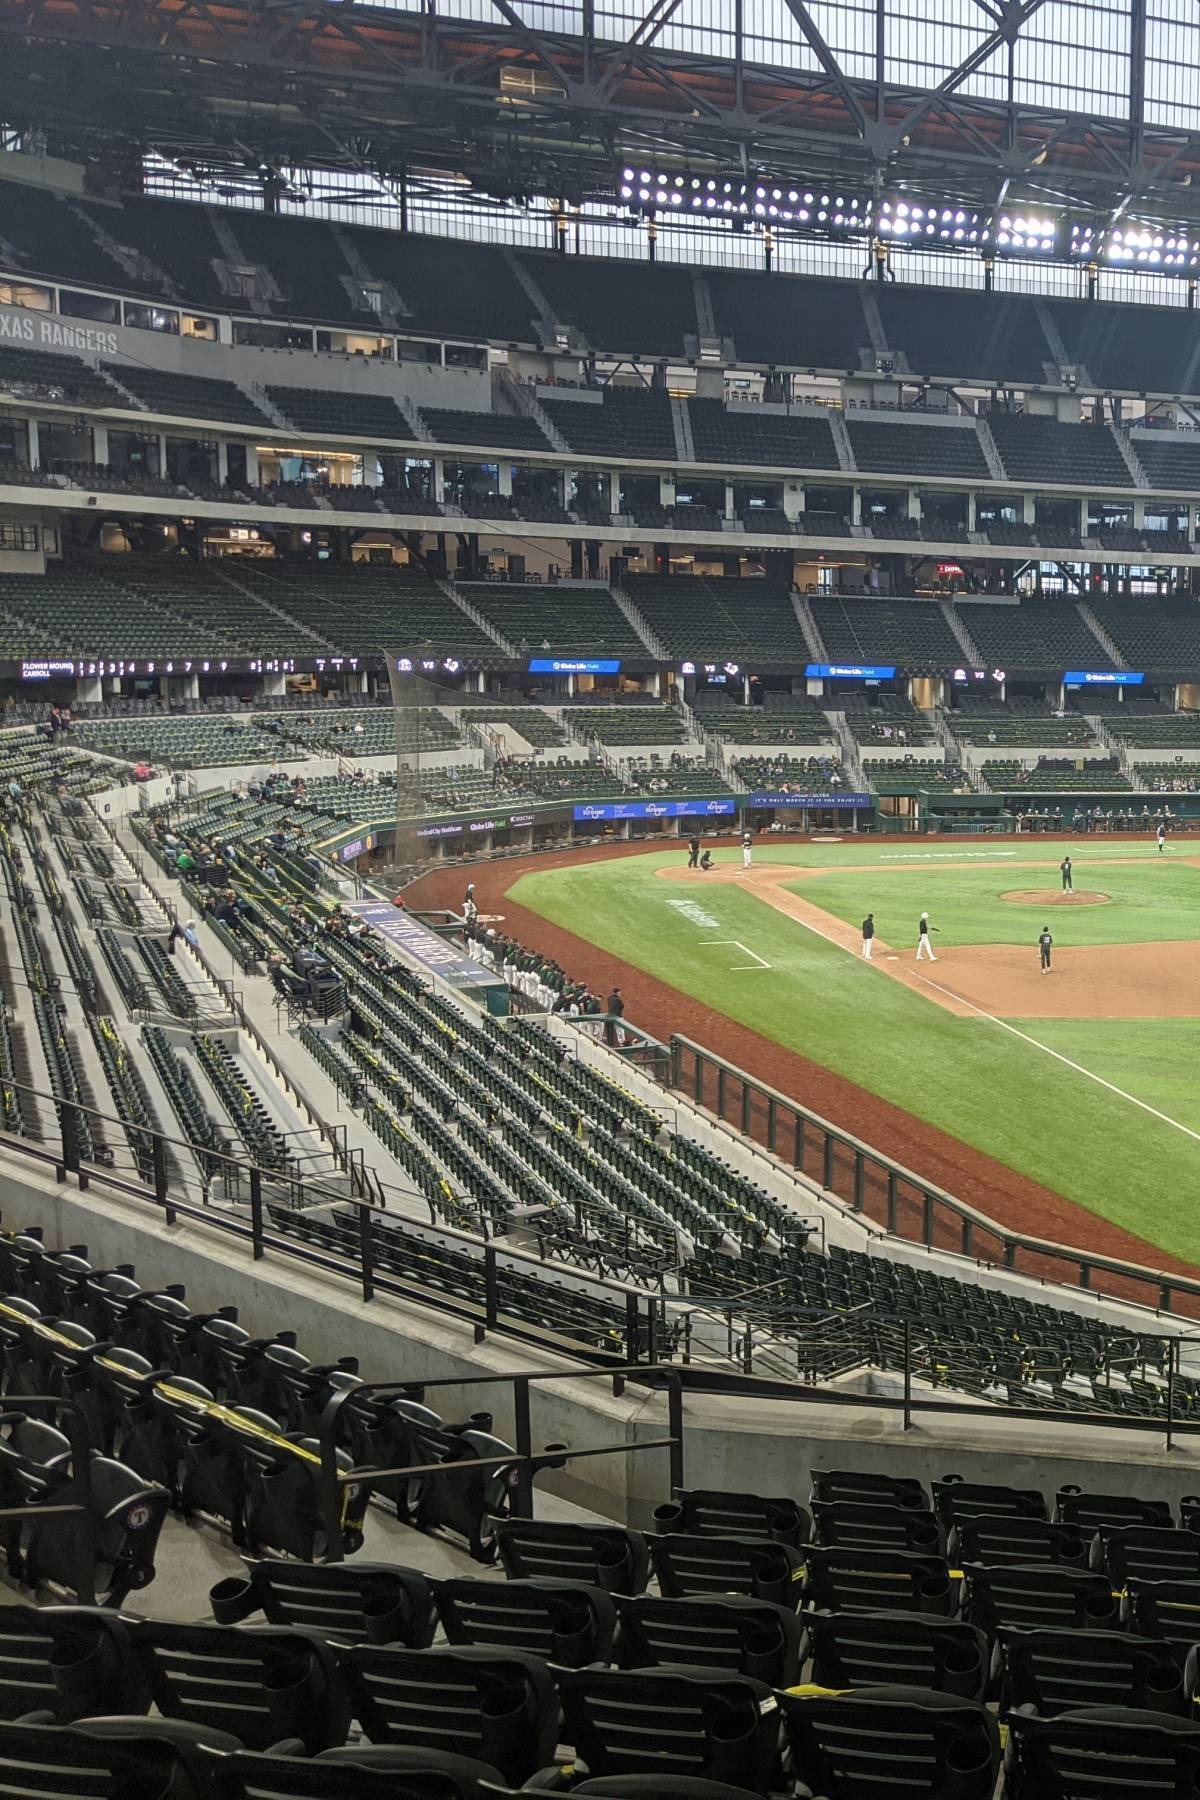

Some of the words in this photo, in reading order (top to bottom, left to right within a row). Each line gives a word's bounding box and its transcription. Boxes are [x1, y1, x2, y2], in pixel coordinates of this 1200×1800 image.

[40, 321, 118, 354] RANGERS
[583, 806, 605, 819] Kroger
[645, 803, 668, 816] Kroger
[707, 801, 729, 813] Kroger
[470, 823, 485, 831] Globe
